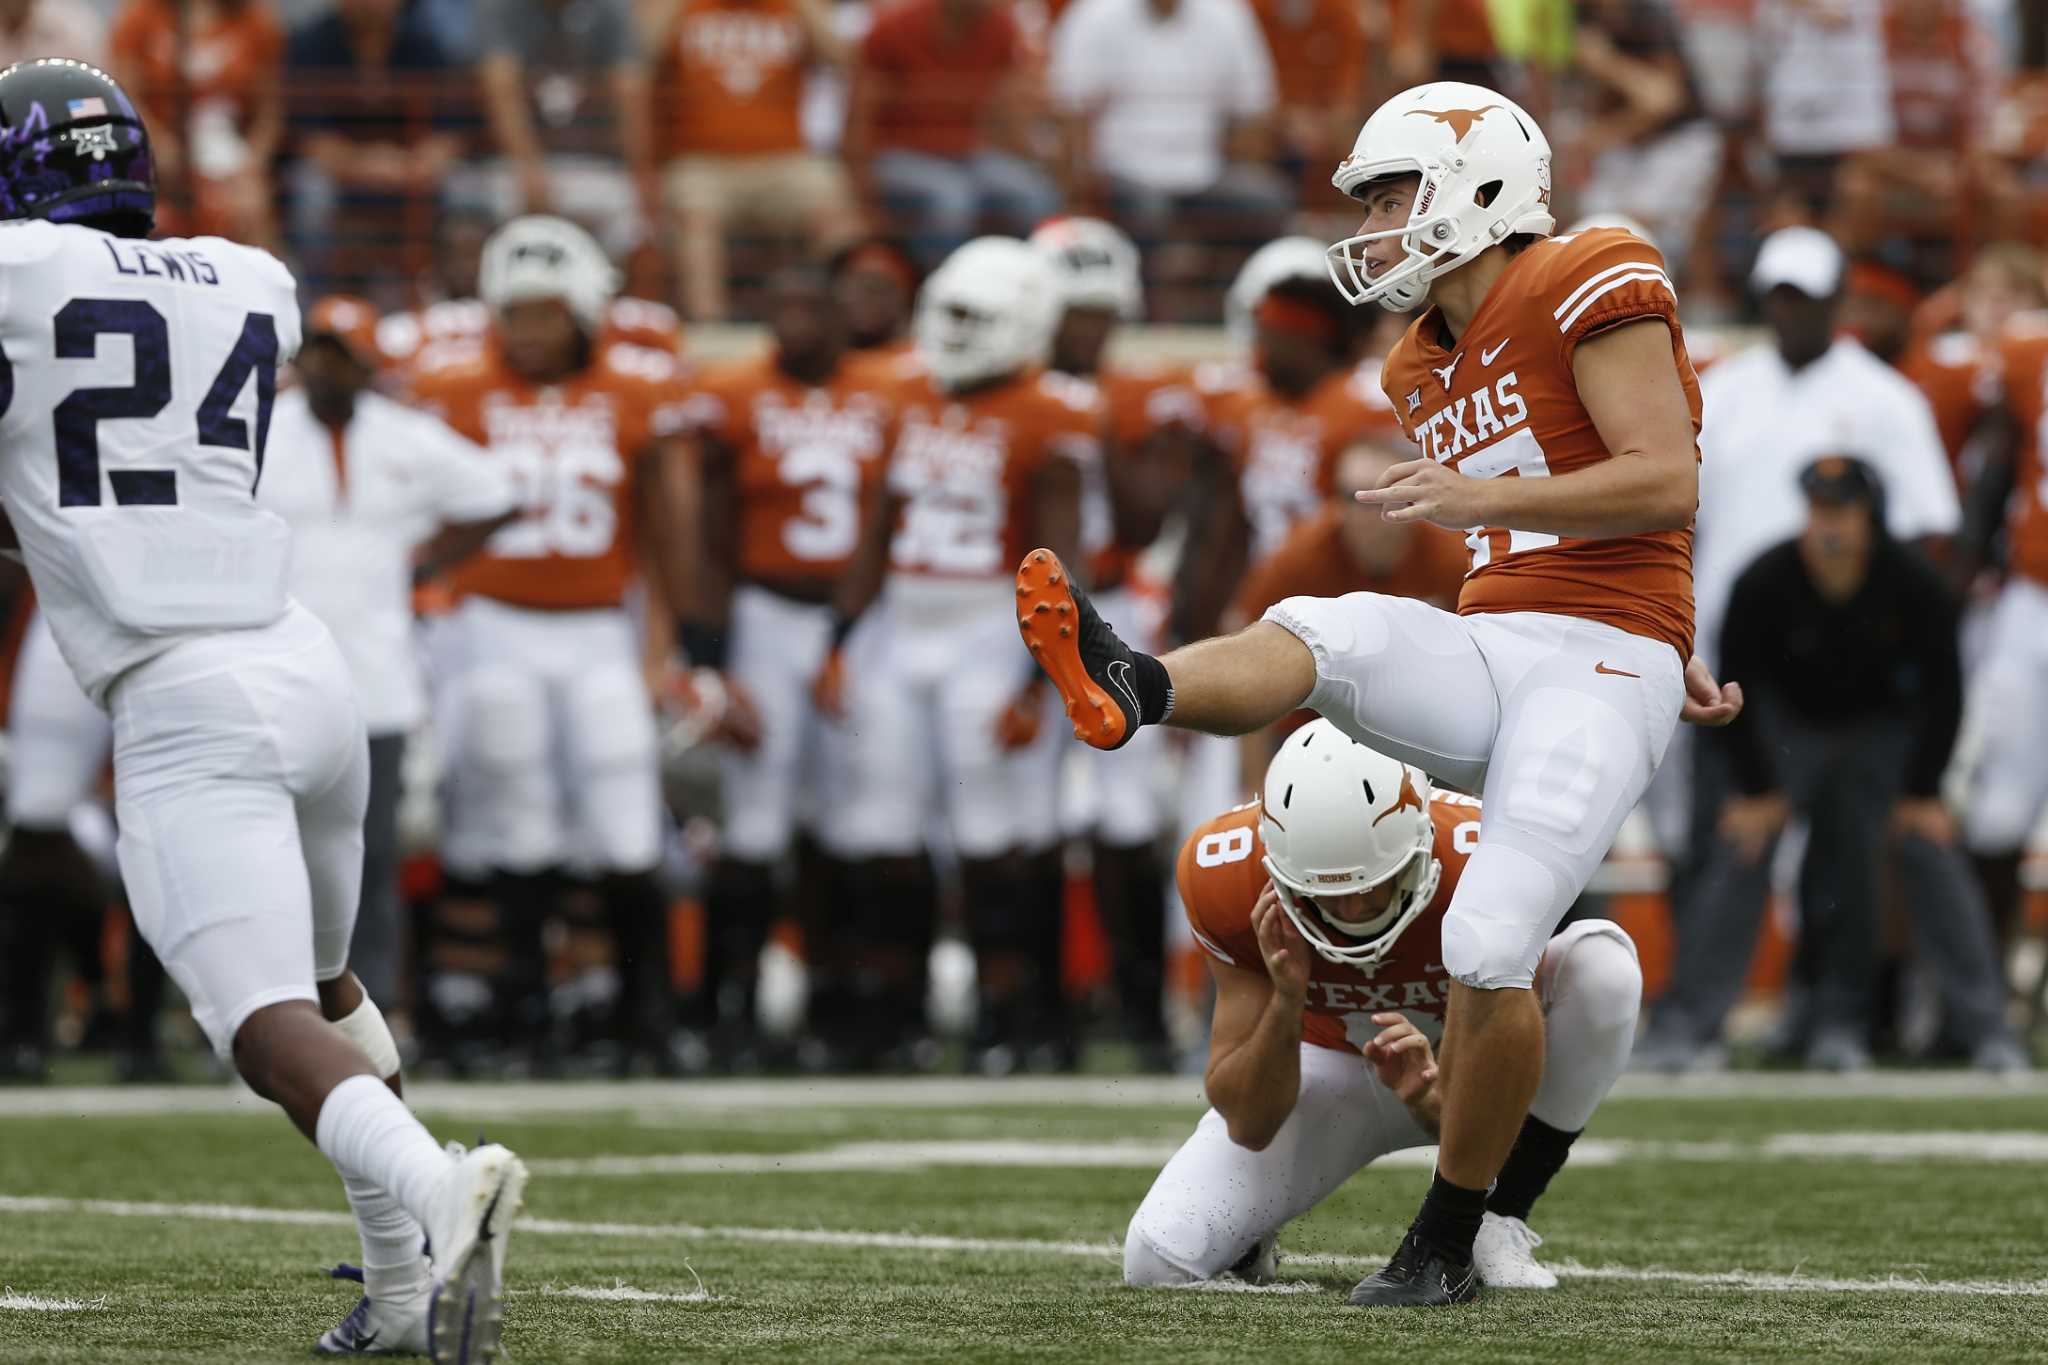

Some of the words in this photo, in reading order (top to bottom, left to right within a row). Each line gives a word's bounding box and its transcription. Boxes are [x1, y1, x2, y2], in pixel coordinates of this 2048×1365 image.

[103, 238, 219, 286] LEWIS
[53, 298, 279, 508] 24
[1414, 371, 1528, 465] TEXAS
[1196, 826, 1253, 868] 8
[1318, 872, 1353, 884] HORNS
